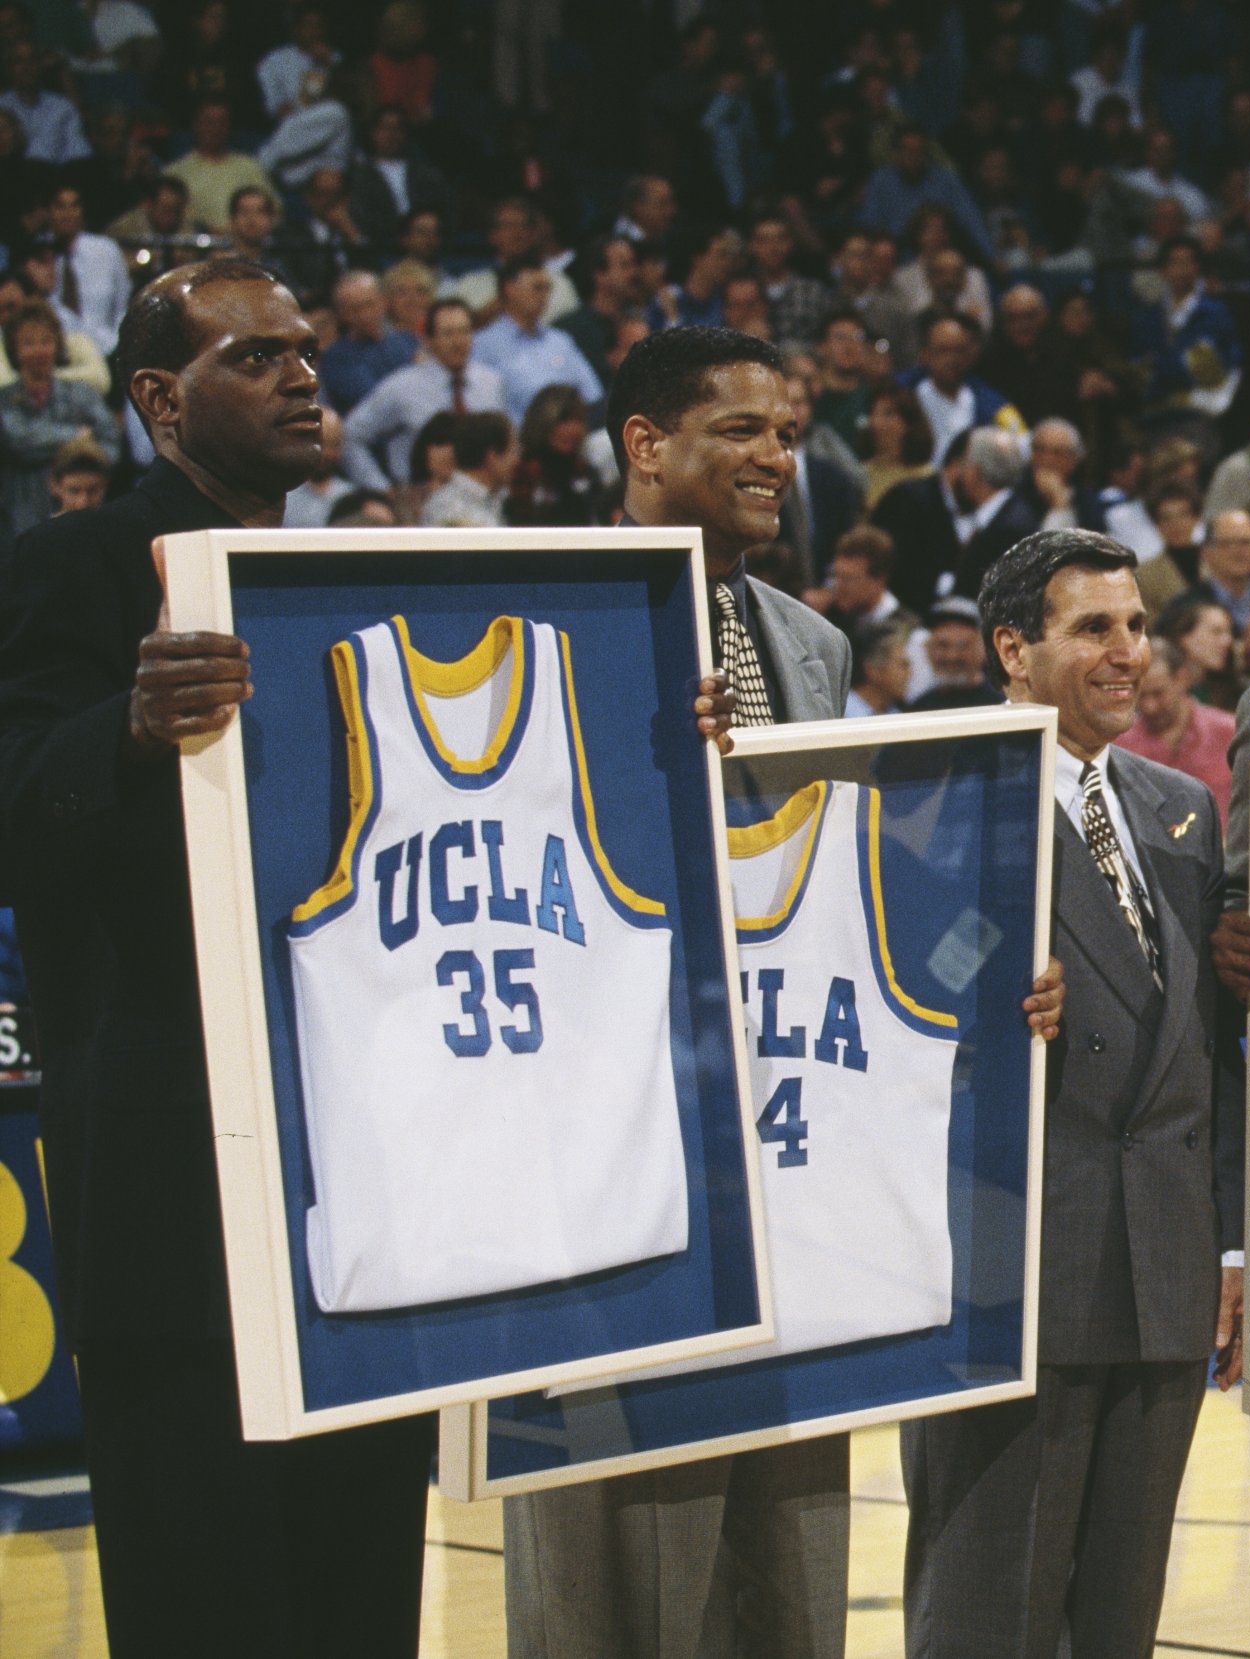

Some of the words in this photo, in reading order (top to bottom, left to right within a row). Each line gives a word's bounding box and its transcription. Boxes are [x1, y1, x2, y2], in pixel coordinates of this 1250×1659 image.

[374, 819, 587, 952] UCLA
[435, 948, 544, 1058] 35
[740, 968, 869, 1073] LA
